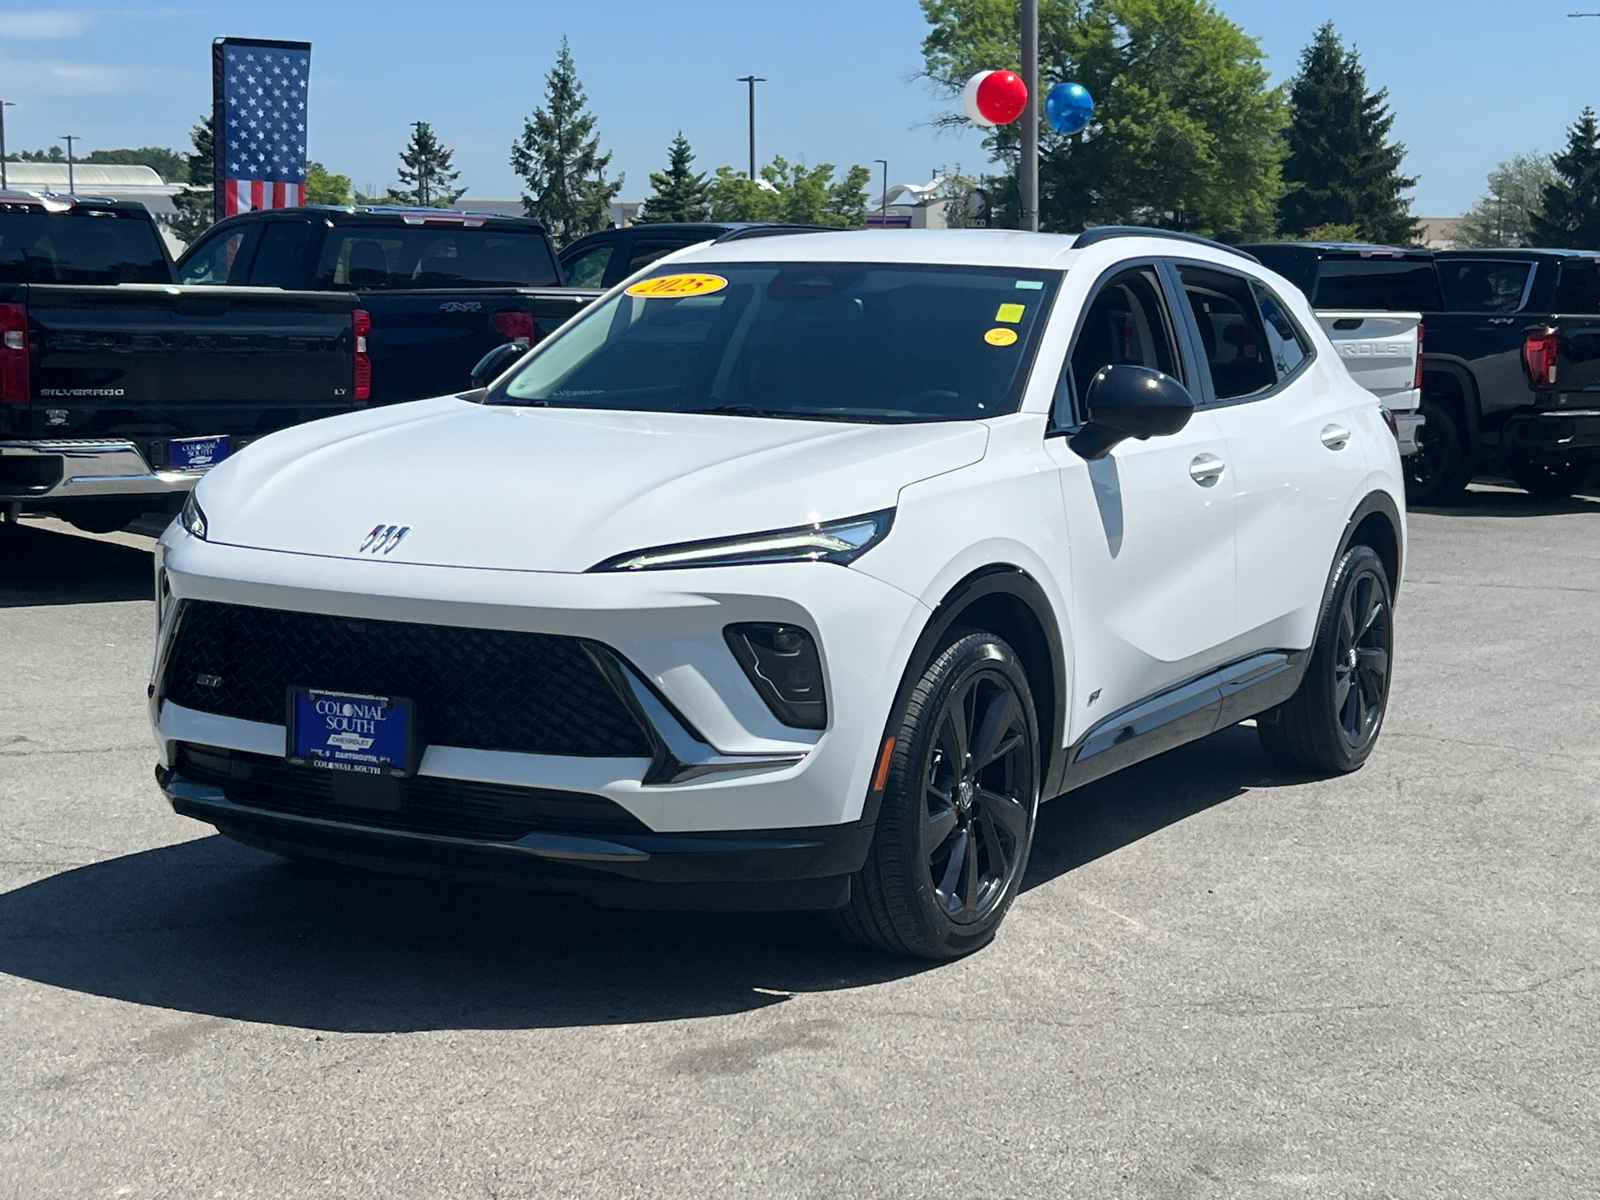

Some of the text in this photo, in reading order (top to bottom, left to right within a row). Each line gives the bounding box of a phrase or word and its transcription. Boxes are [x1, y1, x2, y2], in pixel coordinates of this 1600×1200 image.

[635, 278, 714, 293] 2025
[1338, 342, 1411, 356] ROLET
[40, 388, 125, 396] SILVERADO
[316, 700, 387, 721] COLONIAL
[326, 716, 375, 734] SOUTH
